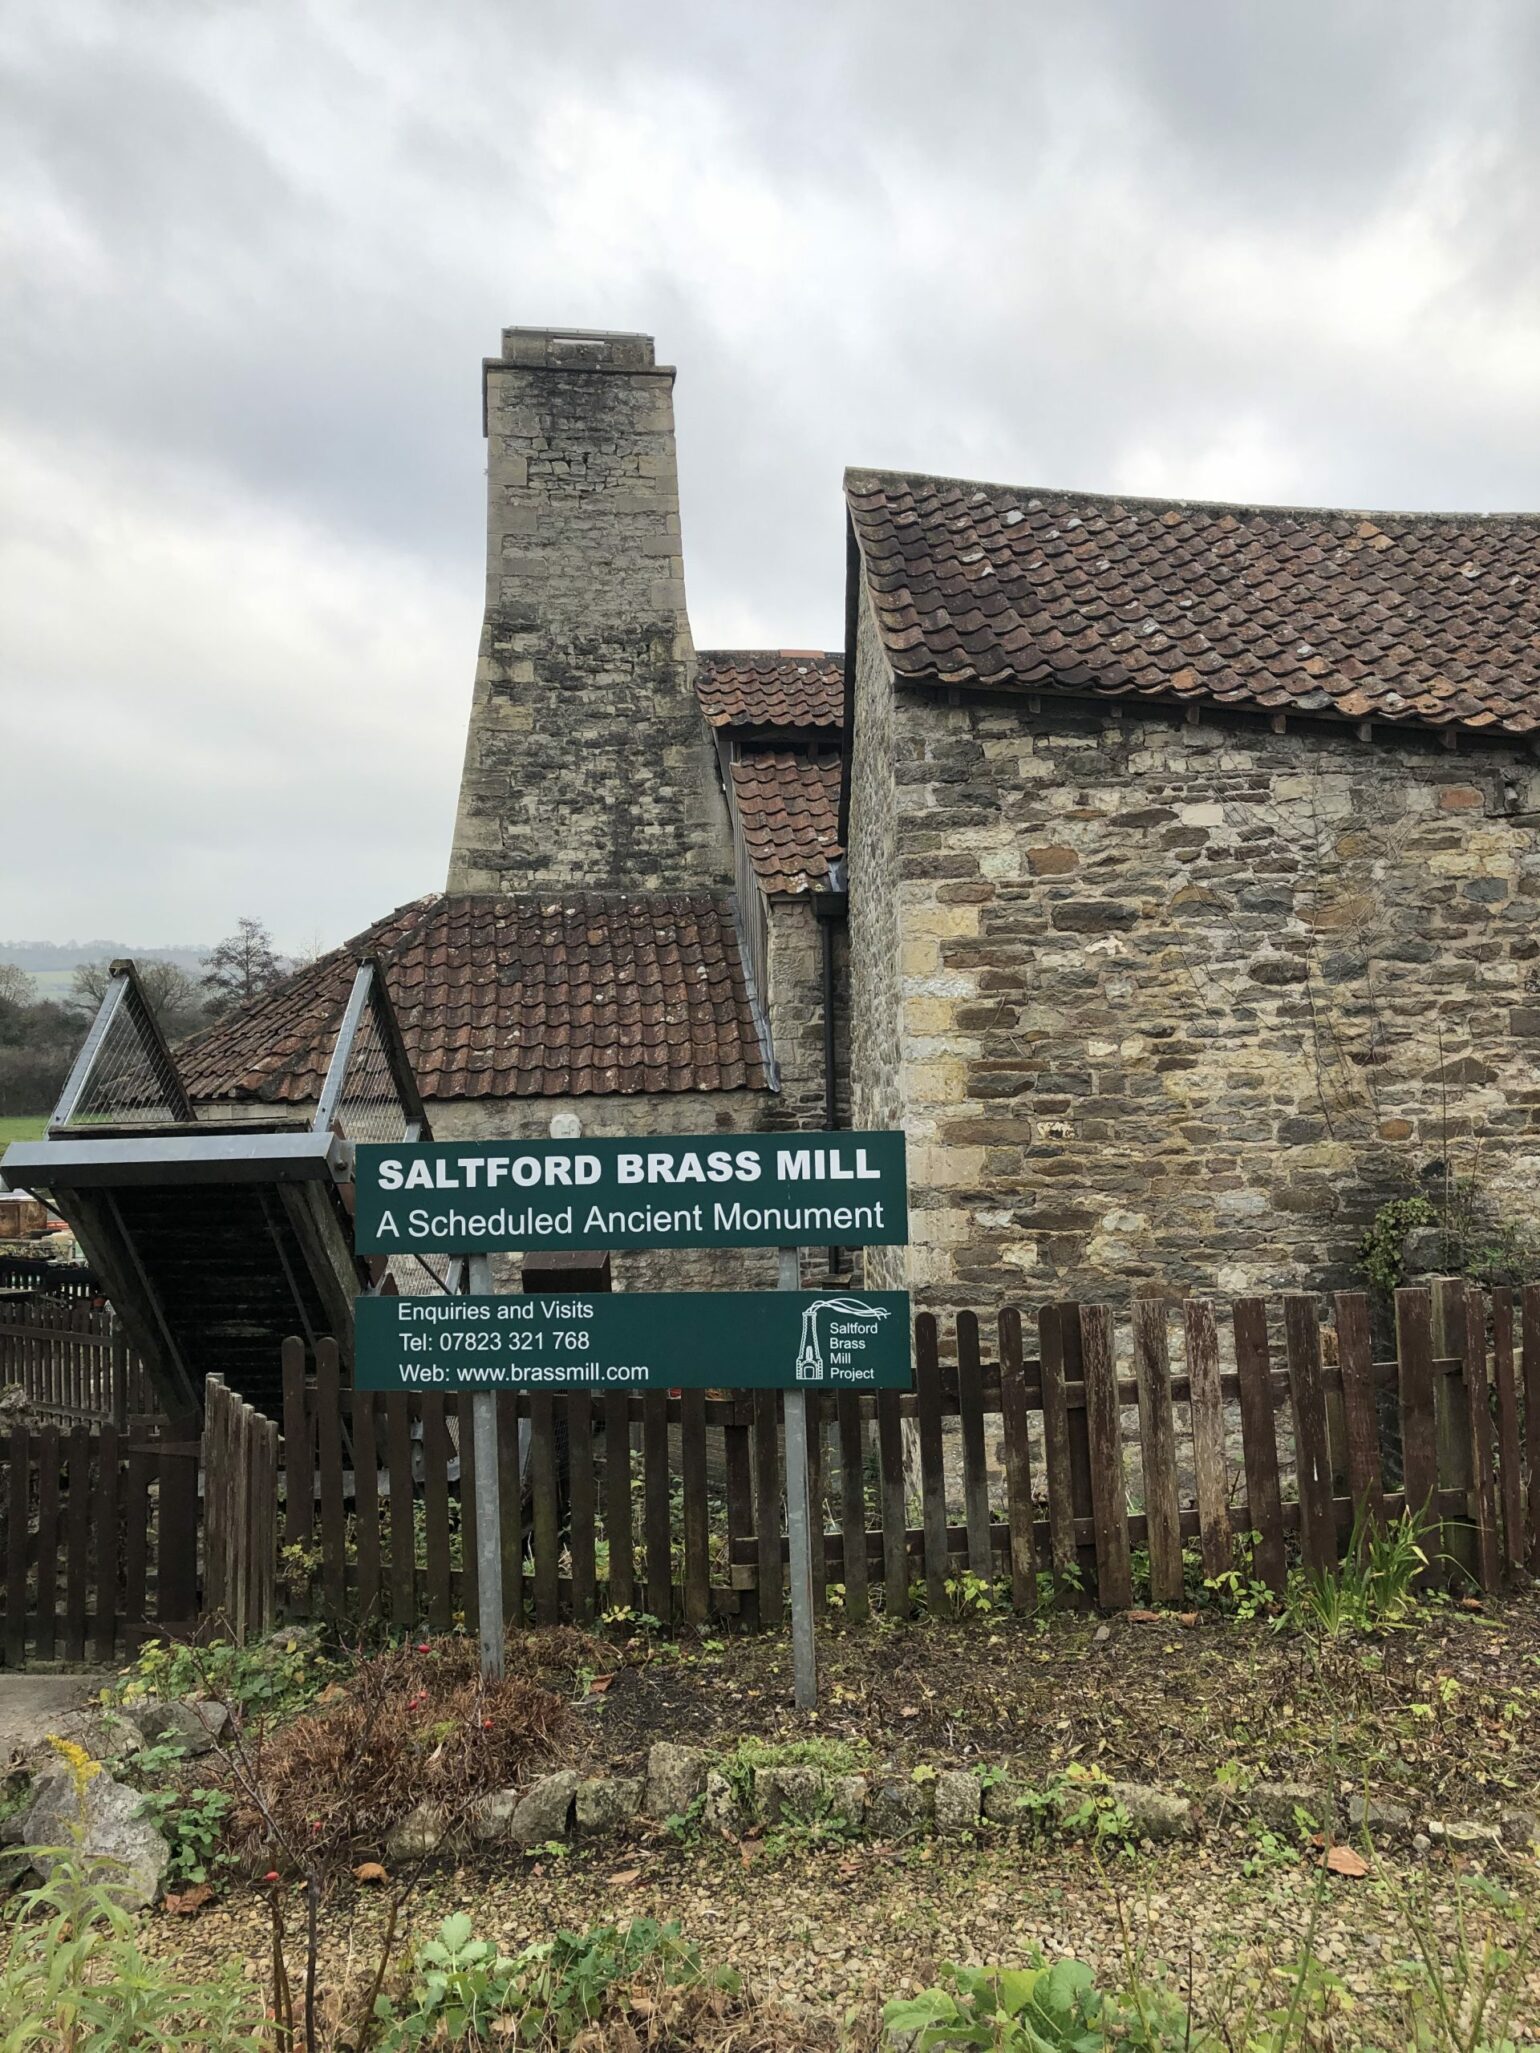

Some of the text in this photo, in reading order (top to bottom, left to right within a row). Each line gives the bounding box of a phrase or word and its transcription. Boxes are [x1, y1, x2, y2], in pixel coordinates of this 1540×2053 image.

[378, 1149, 880, 1190] SALTFORD BRASS MILL
[376, 1202, 884, 1237] A Scheduled Ancient Monument
[399, 1301, 593, 1323] Enquiries and Visits
[830, 1322, 877, 1334] Saltford
[399, 1331, 589, 1351] Tel: 07823 321 768
[830, 1338, 865, 1349] Brass
[831, 1353, 850, 1363] Mill
[399, 1363, 648, 1381] Web: www.brassmill.com
[831, 1368, 874, 1381] Project
